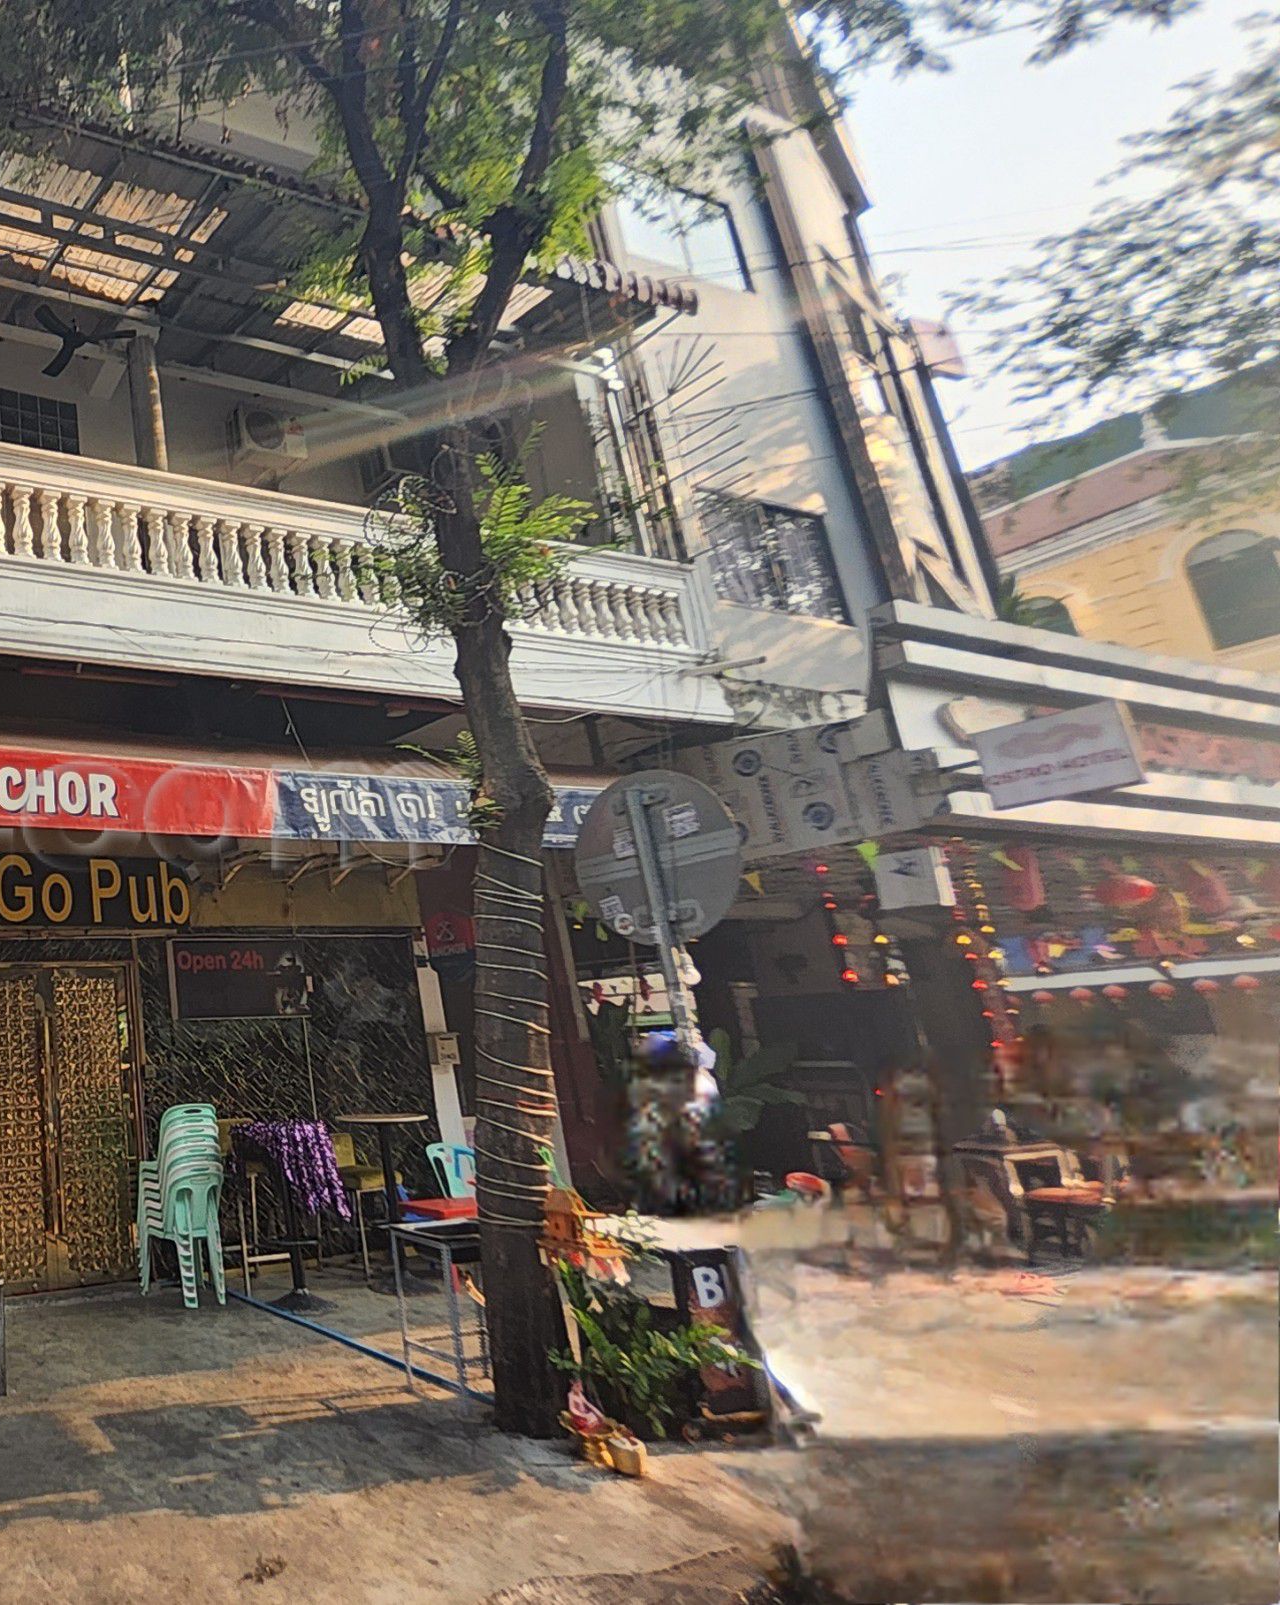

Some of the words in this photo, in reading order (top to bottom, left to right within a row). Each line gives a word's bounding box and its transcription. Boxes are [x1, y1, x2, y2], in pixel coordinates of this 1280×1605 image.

[89, 858, 190, 925] Pub
[176, 951, 226, 974] Open
[229, 951, 264, 970] 24h
